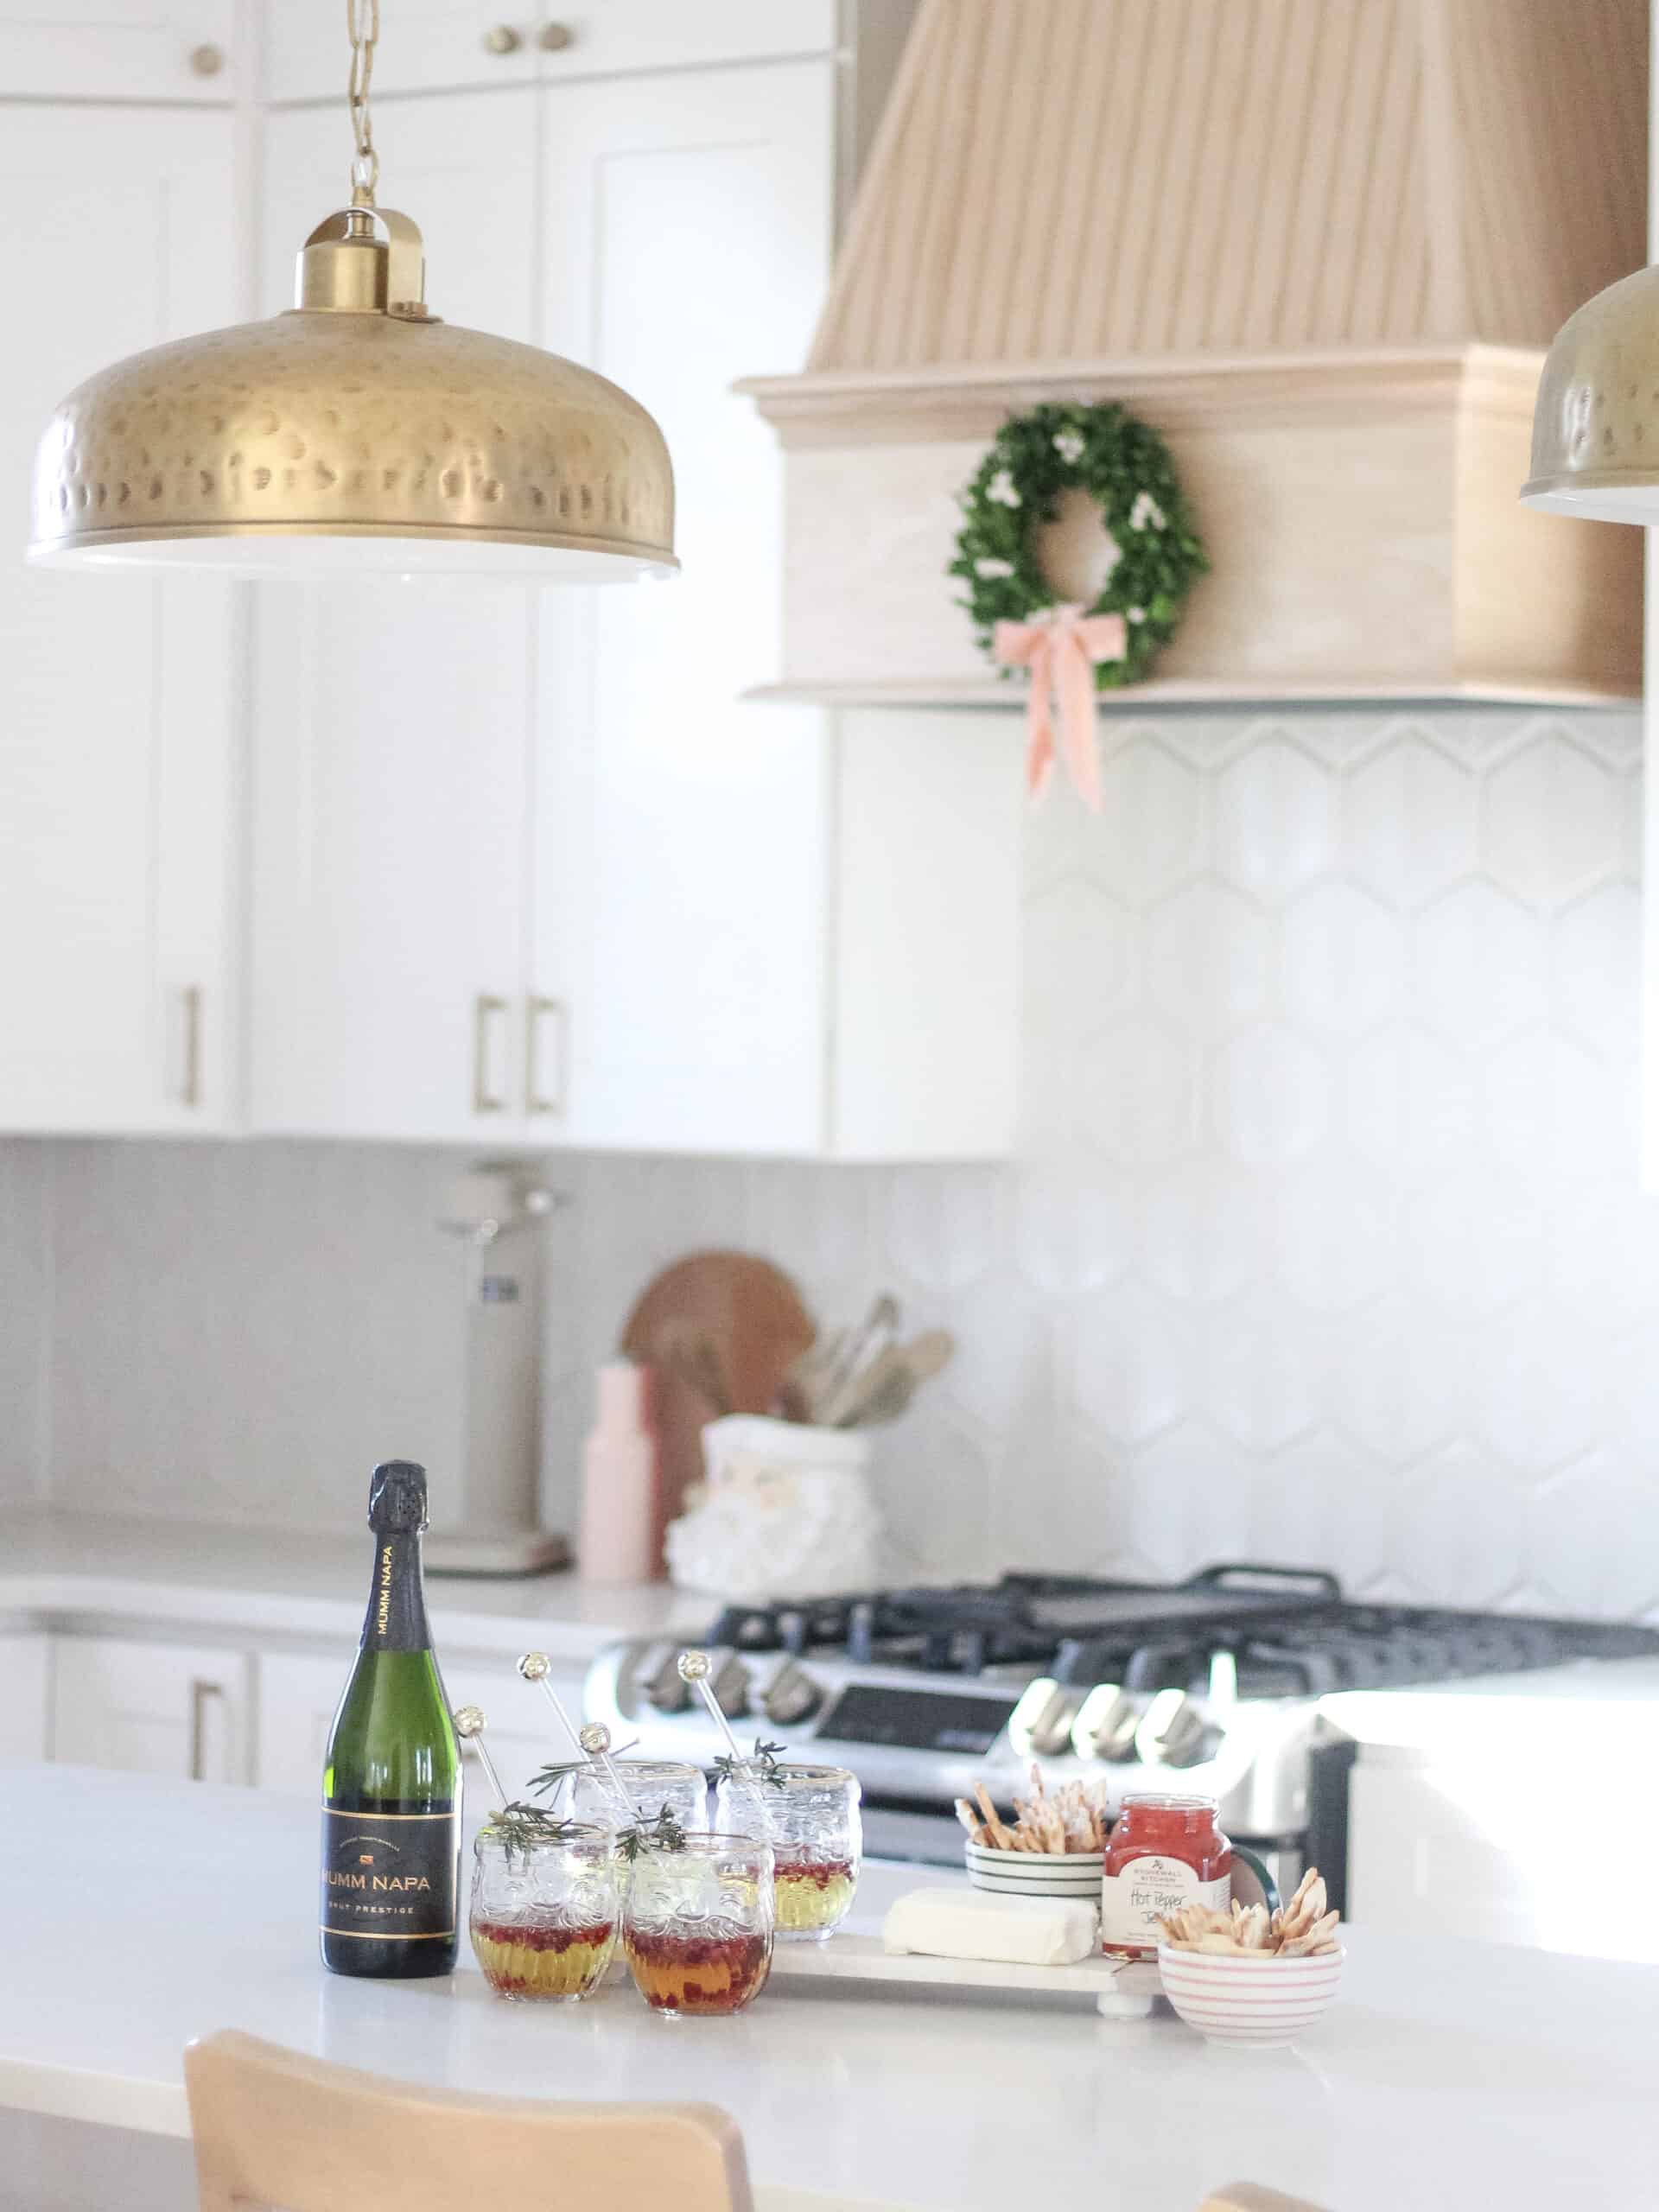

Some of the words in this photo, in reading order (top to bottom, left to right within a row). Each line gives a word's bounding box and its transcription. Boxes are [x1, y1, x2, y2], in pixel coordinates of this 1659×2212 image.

[381, 1545, 393, 1586] NAPA
[378, 1589, 391, 1635] MUMM
[372, 1874, 431, 1891] NAPA
[355, 1904, 415, 1915] PRESTIGE
[1131, 1887, 1153, 1907] Hot
[1154, 1891, 1188, 1910] Pepper
